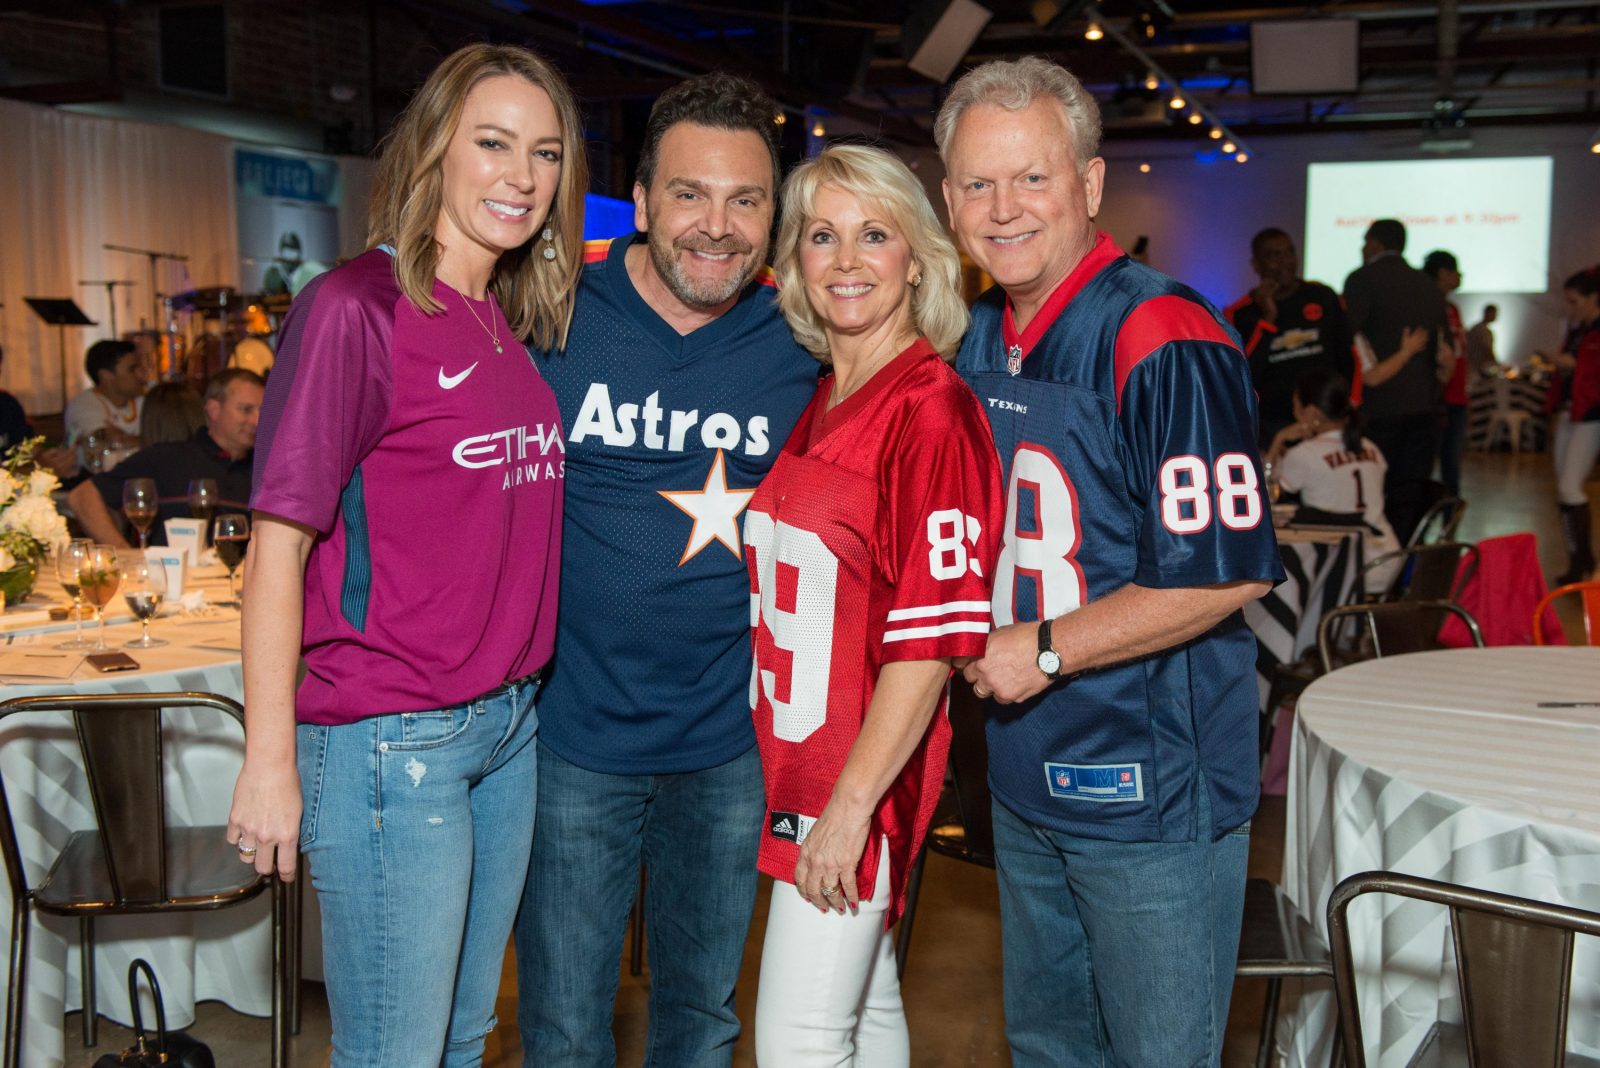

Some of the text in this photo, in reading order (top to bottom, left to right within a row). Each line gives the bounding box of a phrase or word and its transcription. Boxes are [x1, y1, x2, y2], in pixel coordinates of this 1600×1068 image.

[568, 382, 770, 456] Astros
[987, 397, 1028, 414] TEXNS
[1158, 452, 1263, 535] 88
[1351, 468, 1367, 512] 1
[772, 826, 796, 836] adidas
